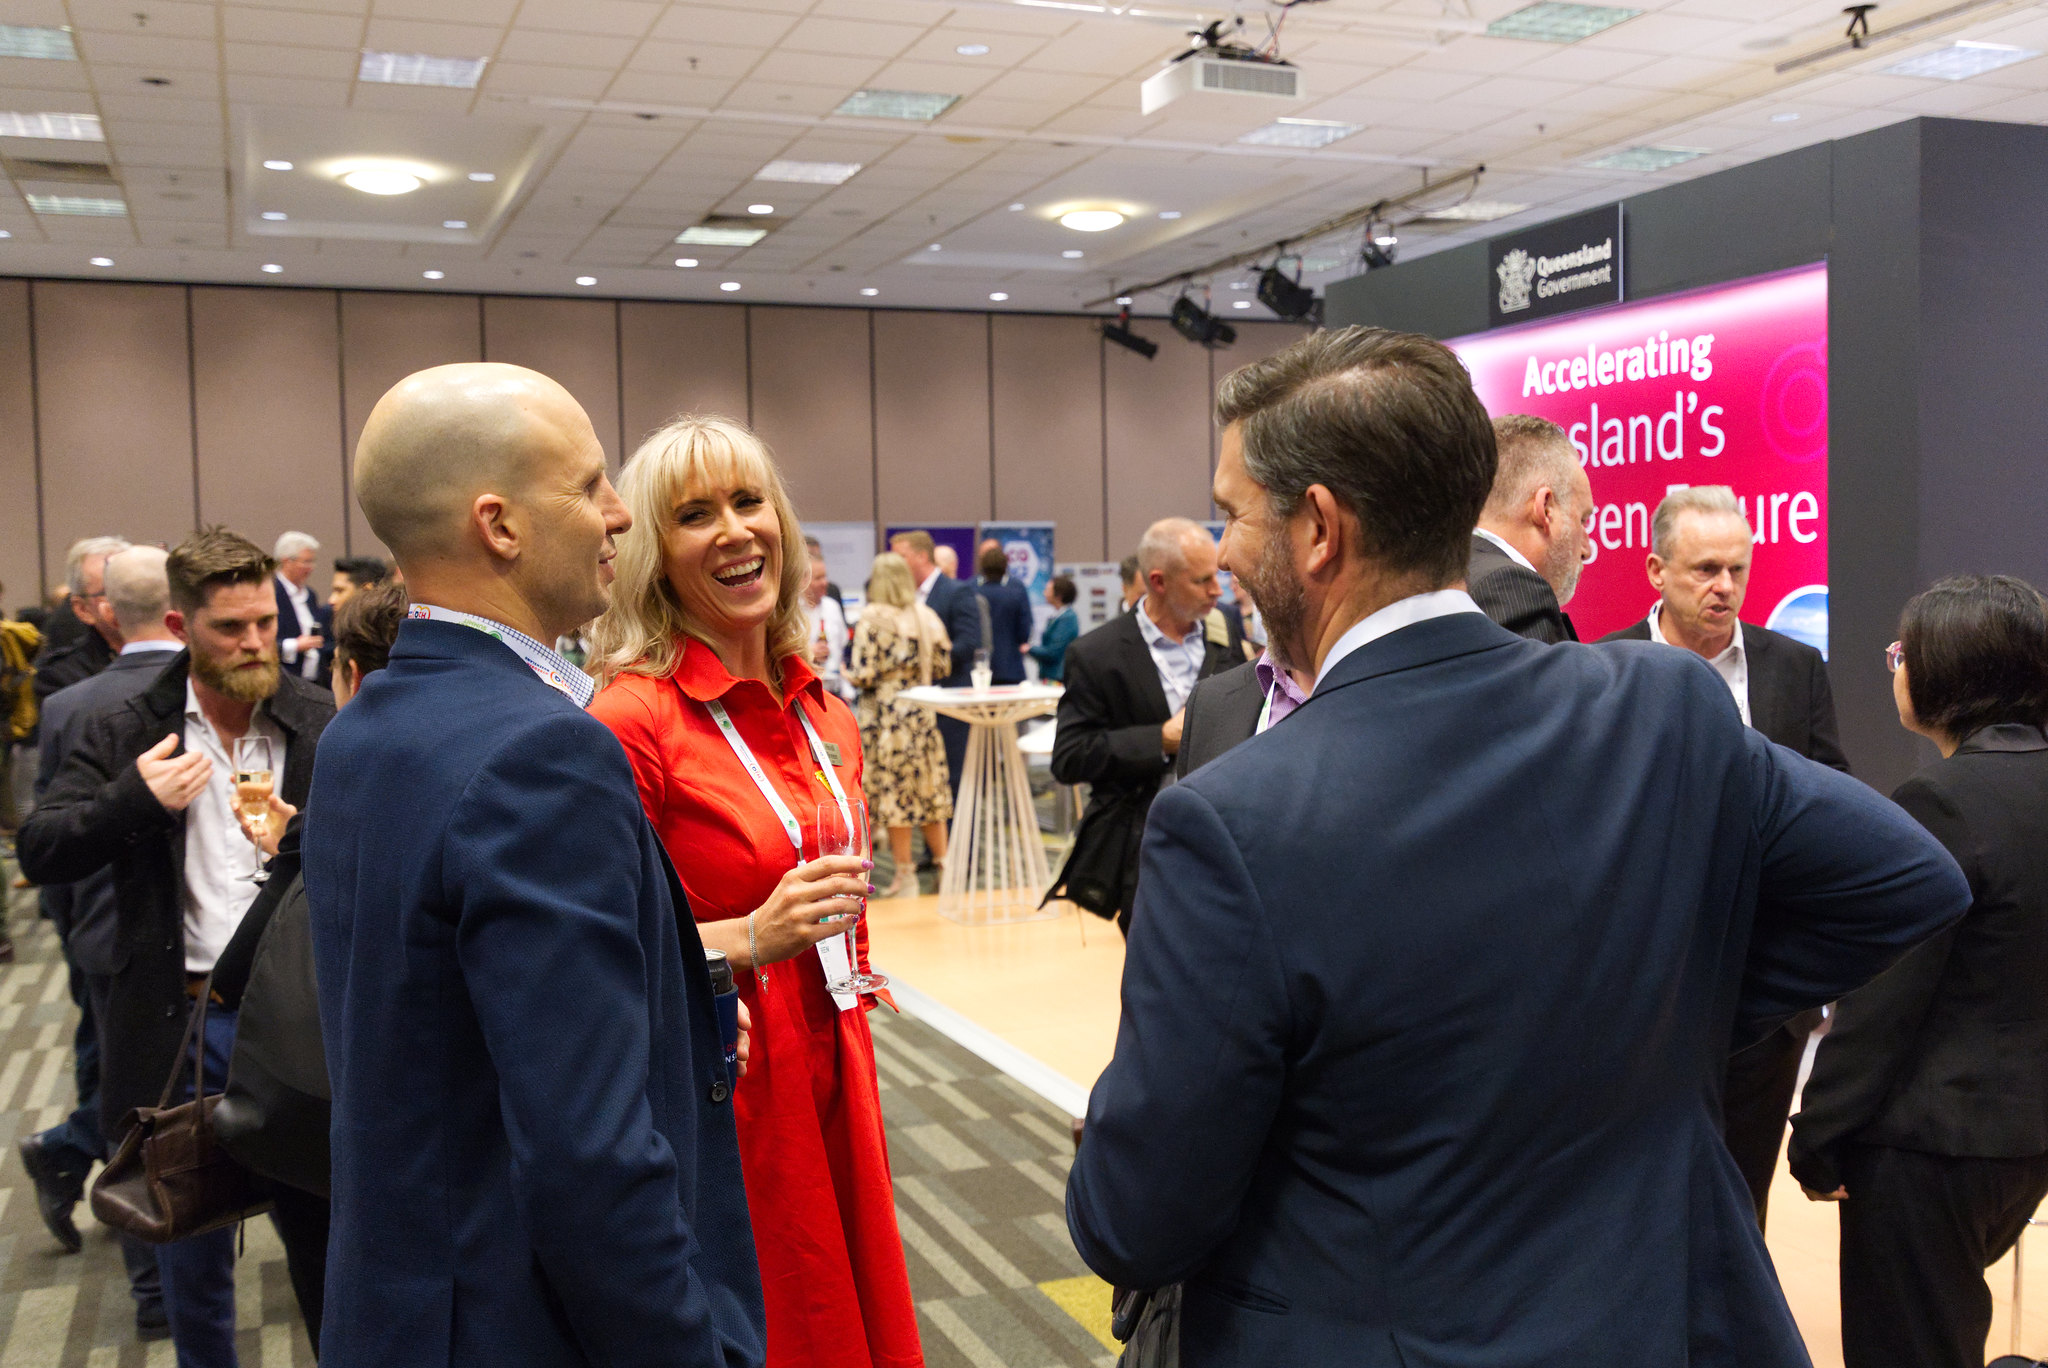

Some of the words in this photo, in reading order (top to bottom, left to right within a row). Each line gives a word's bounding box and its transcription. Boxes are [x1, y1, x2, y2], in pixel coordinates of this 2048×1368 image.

[1536, 236, 1612, 278] Queensland
[1536, 263, 1612, 298] Government
[1522, 330, 1715, 398] Accelerating
[1568, 390, 1726, 468] sland's
